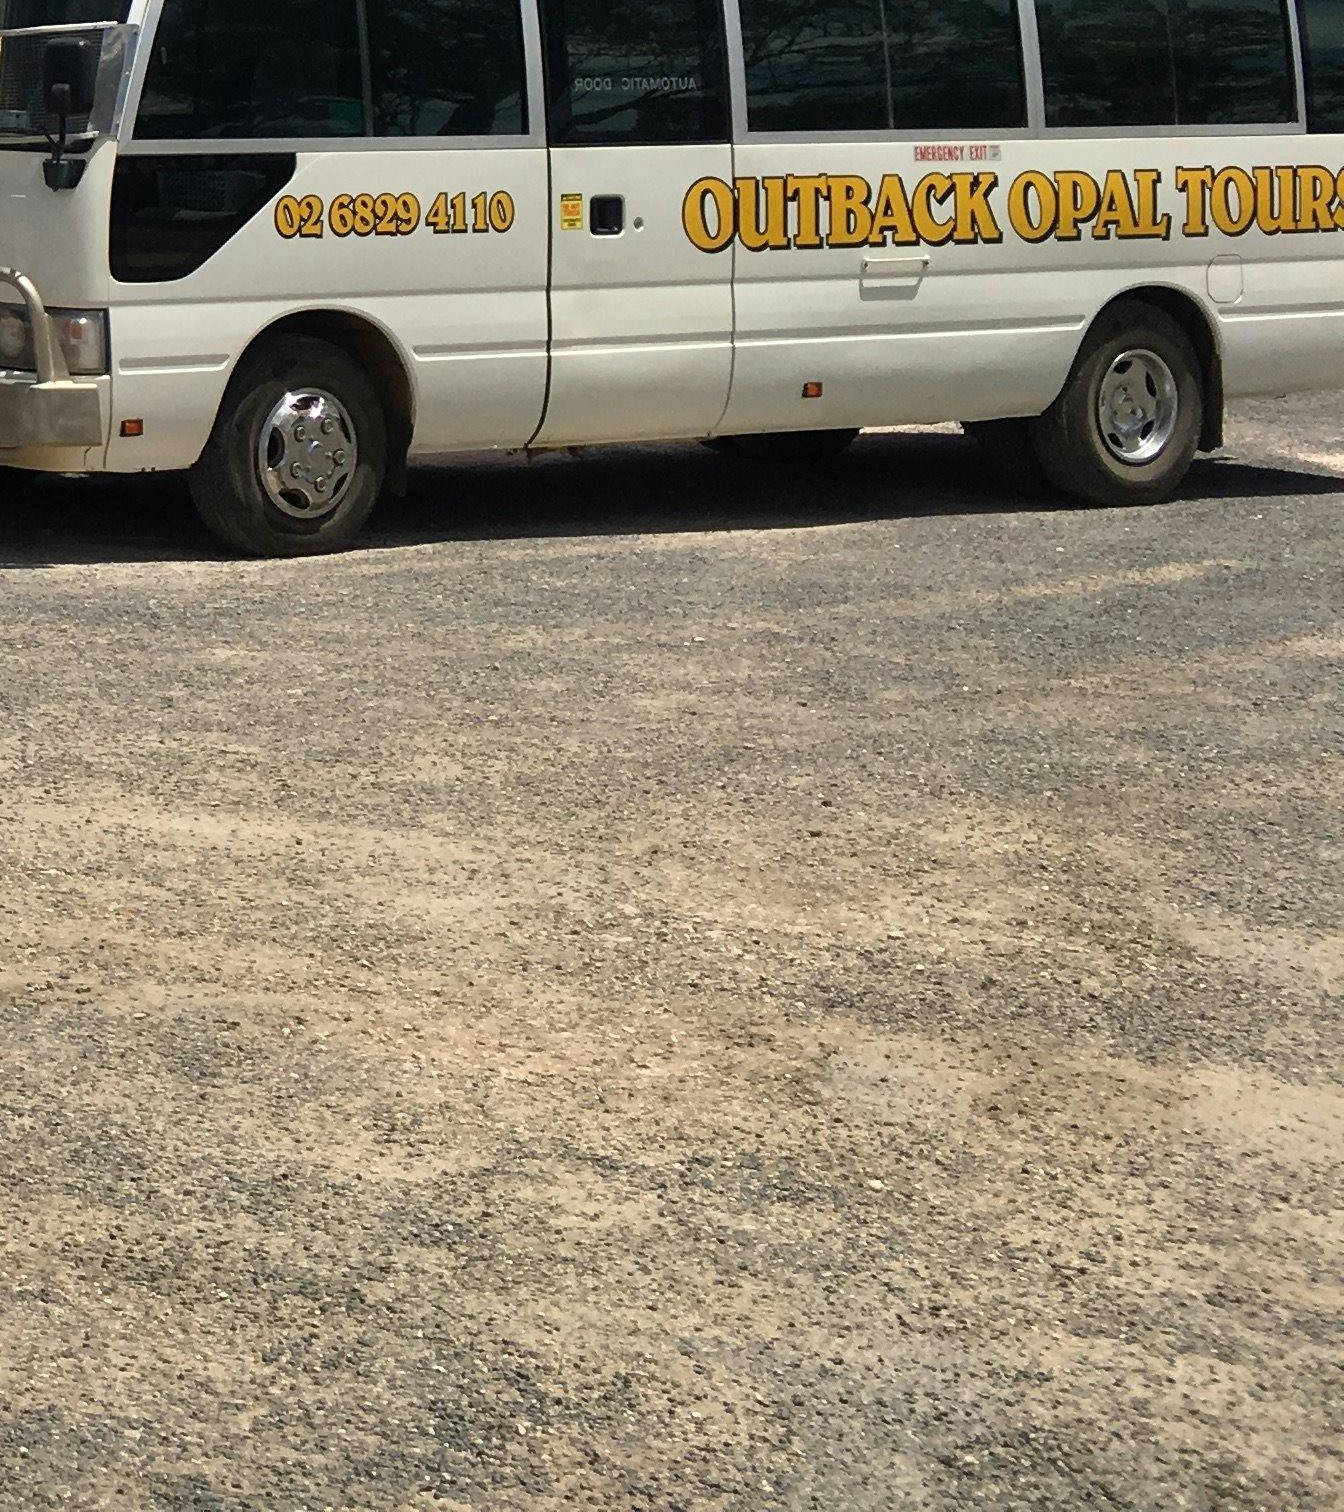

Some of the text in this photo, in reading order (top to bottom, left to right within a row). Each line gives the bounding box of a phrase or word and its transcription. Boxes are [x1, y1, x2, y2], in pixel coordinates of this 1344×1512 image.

[914, 145, 987, 161] EMERGENCY EXIT
[274, 194, 324, 239] 02
[328, 191, 422, 237] 6829
[425, 190, 515, 234] 4110
[682, 172, 1004, 254] OUTBACK
[1008, 169, 1172, 244] OPAL
